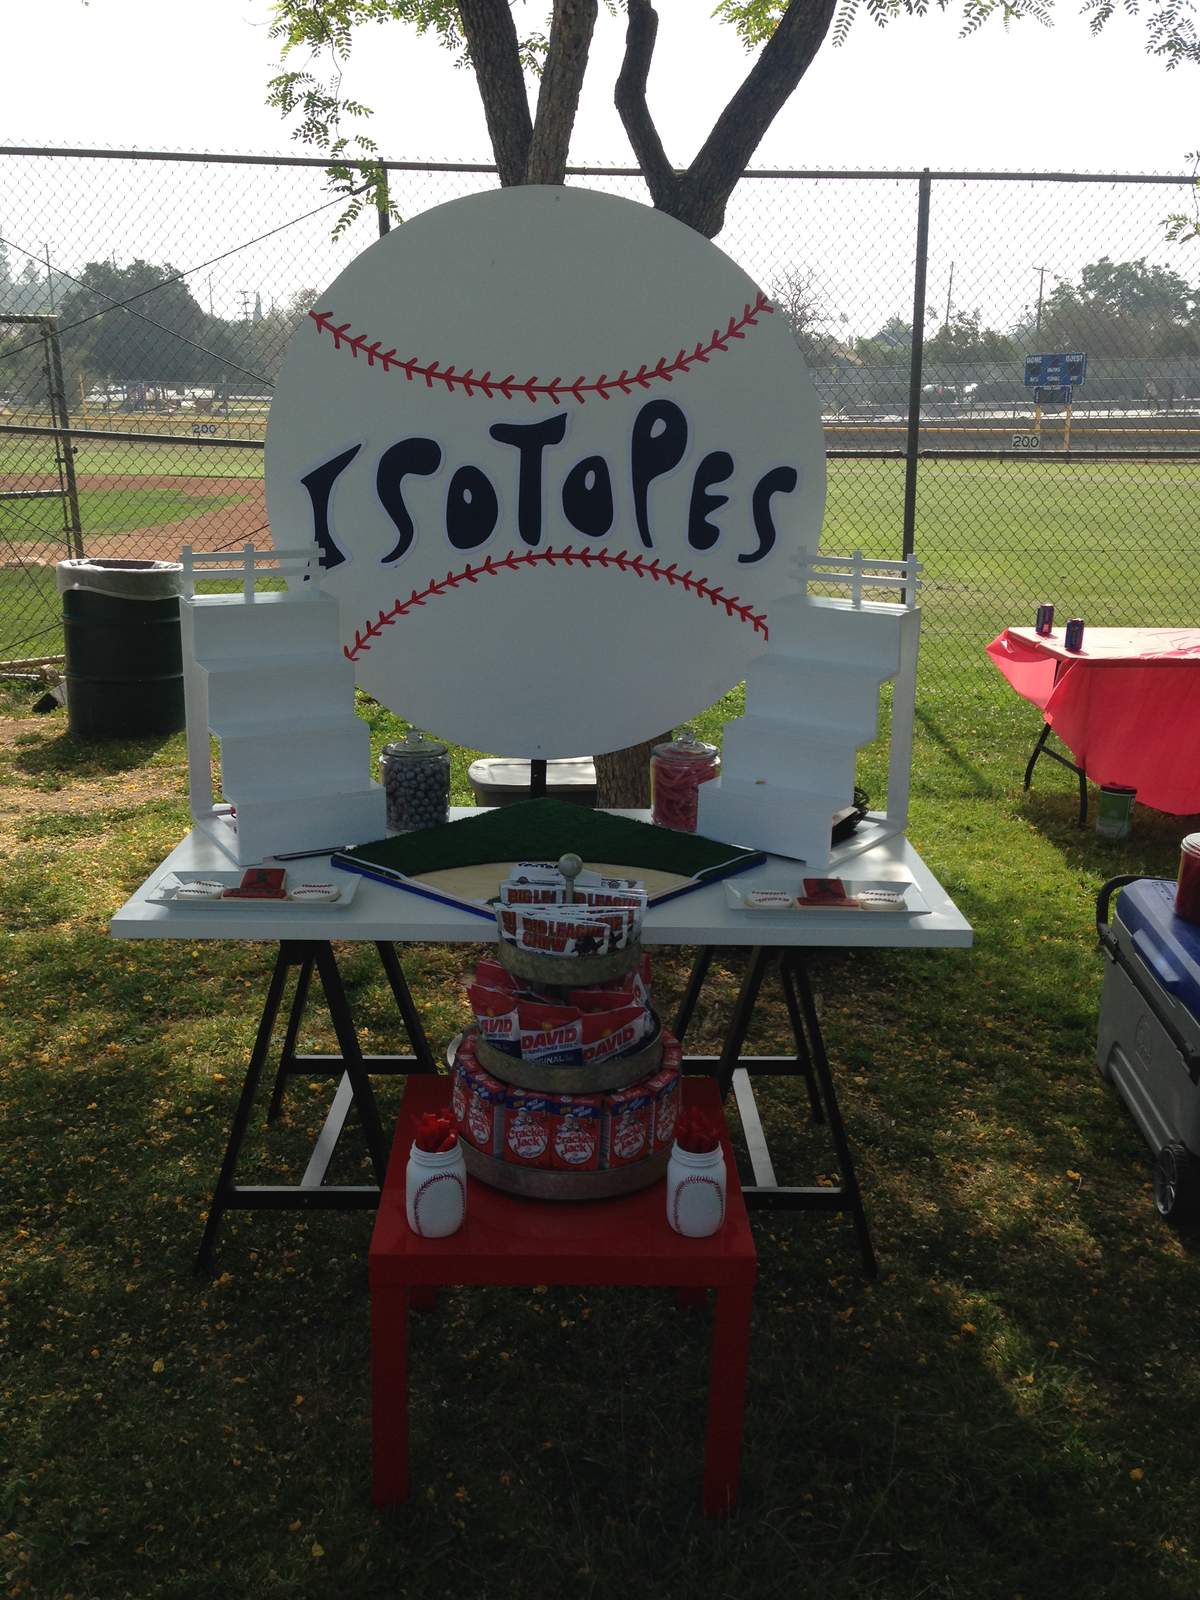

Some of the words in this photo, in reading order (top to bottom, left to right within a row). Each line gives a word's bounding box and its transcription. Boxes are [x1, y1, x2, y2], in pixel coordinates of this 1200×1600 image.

[192, 424, 217, 433] 200
[1012, 435, 1039, 448] 200
[300, 398, 798, 577] ISOTOPES
[480, 1019, 513, 1033] AVID
[521, 1028, 577, 1049] DAVID
[583, 1028, 635, 1060] DAVID
[515, 1137, 540, 1149] Jack
[563, 1142, 587, 1154] Jack
